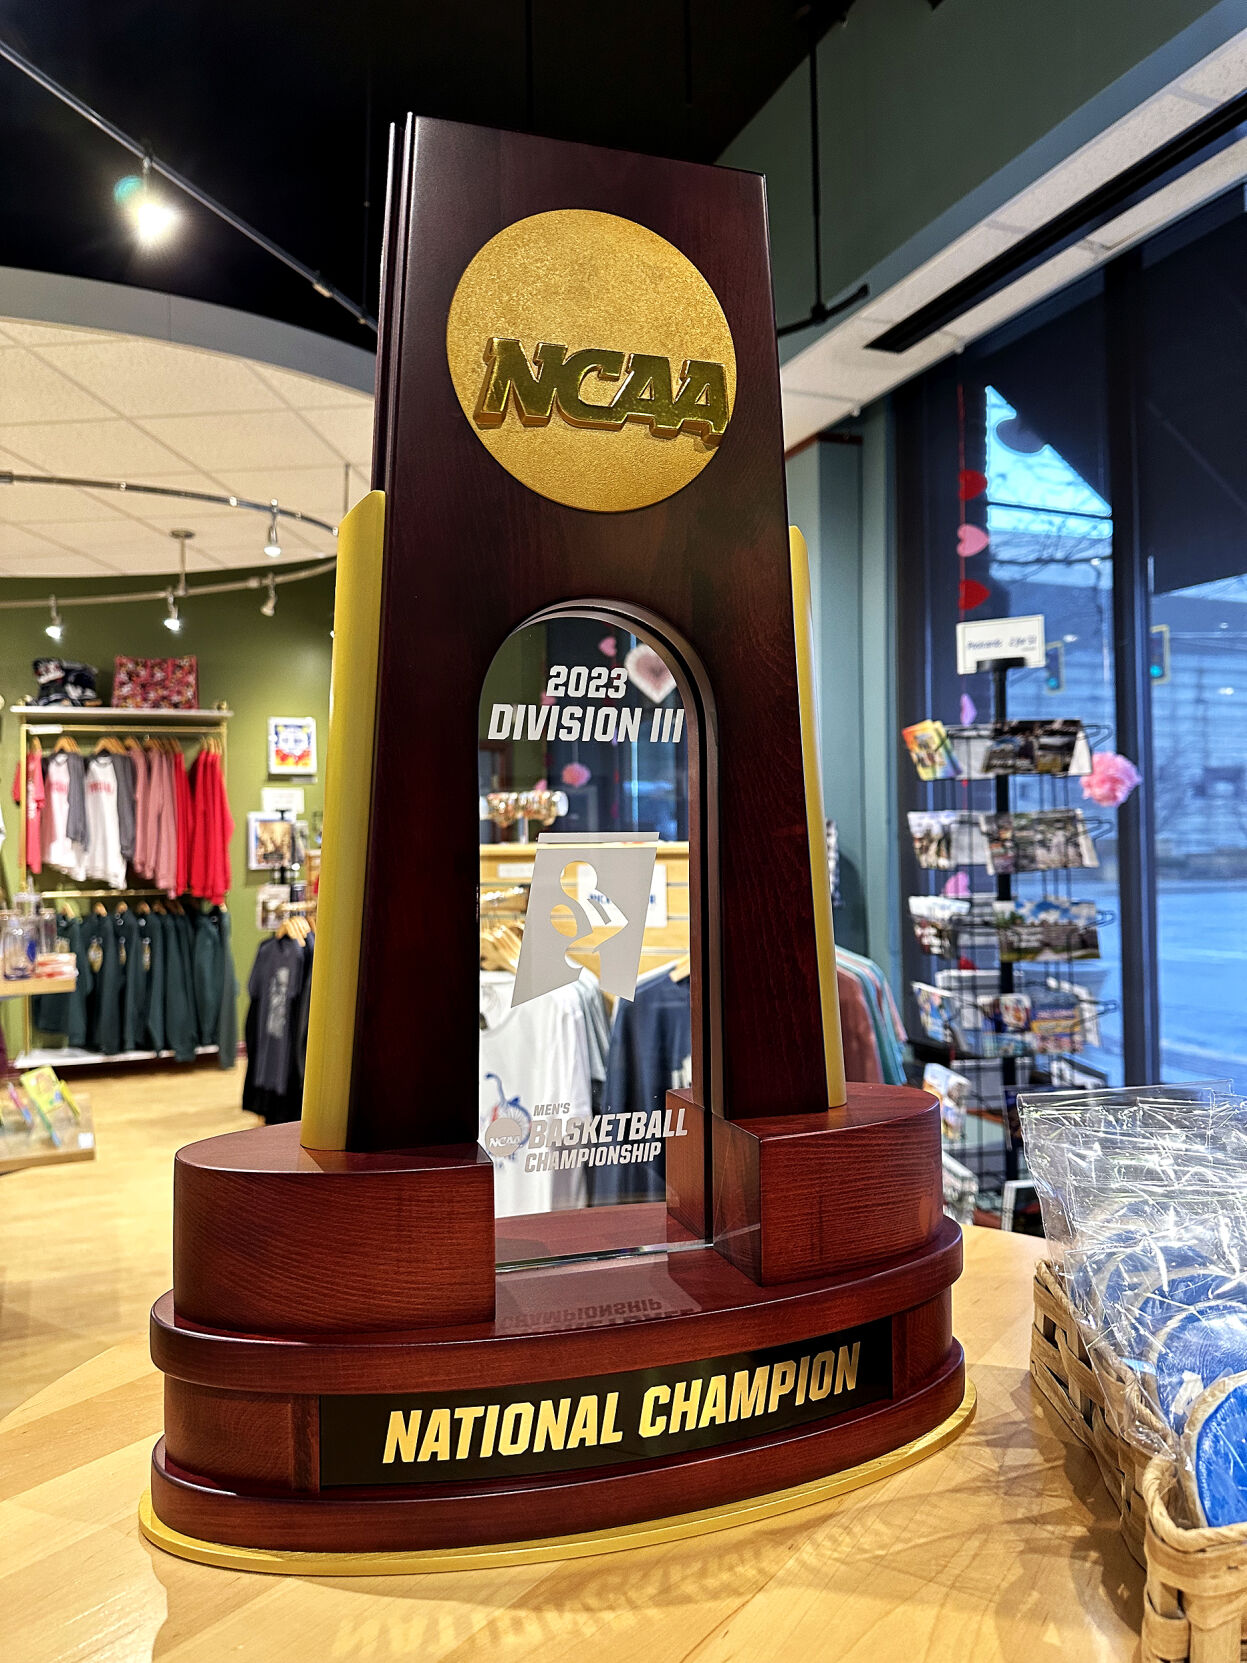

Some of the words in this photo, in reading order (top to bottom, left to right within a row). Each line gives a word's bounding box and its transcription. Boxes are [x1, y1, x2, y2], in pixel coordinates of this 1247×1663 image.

[473, 337, 729, 449] NCAA
[546, 665, 628, 699] 2023
[487, 703, 643, 743] DIVISION
[649, 708, 685, 743] III
[533, 1102, 571, 1117] MEN'S
[489, 1135, 521, 1147] NCAA
[527, 1108, 688, 1150] BASKETBALL
[524, 1141, 662, 1173] CHAMPIONSHIP
[382, 1391, 624, 1464] NATIONAL
[638, 1340, 862, 1438] CHAMPION
